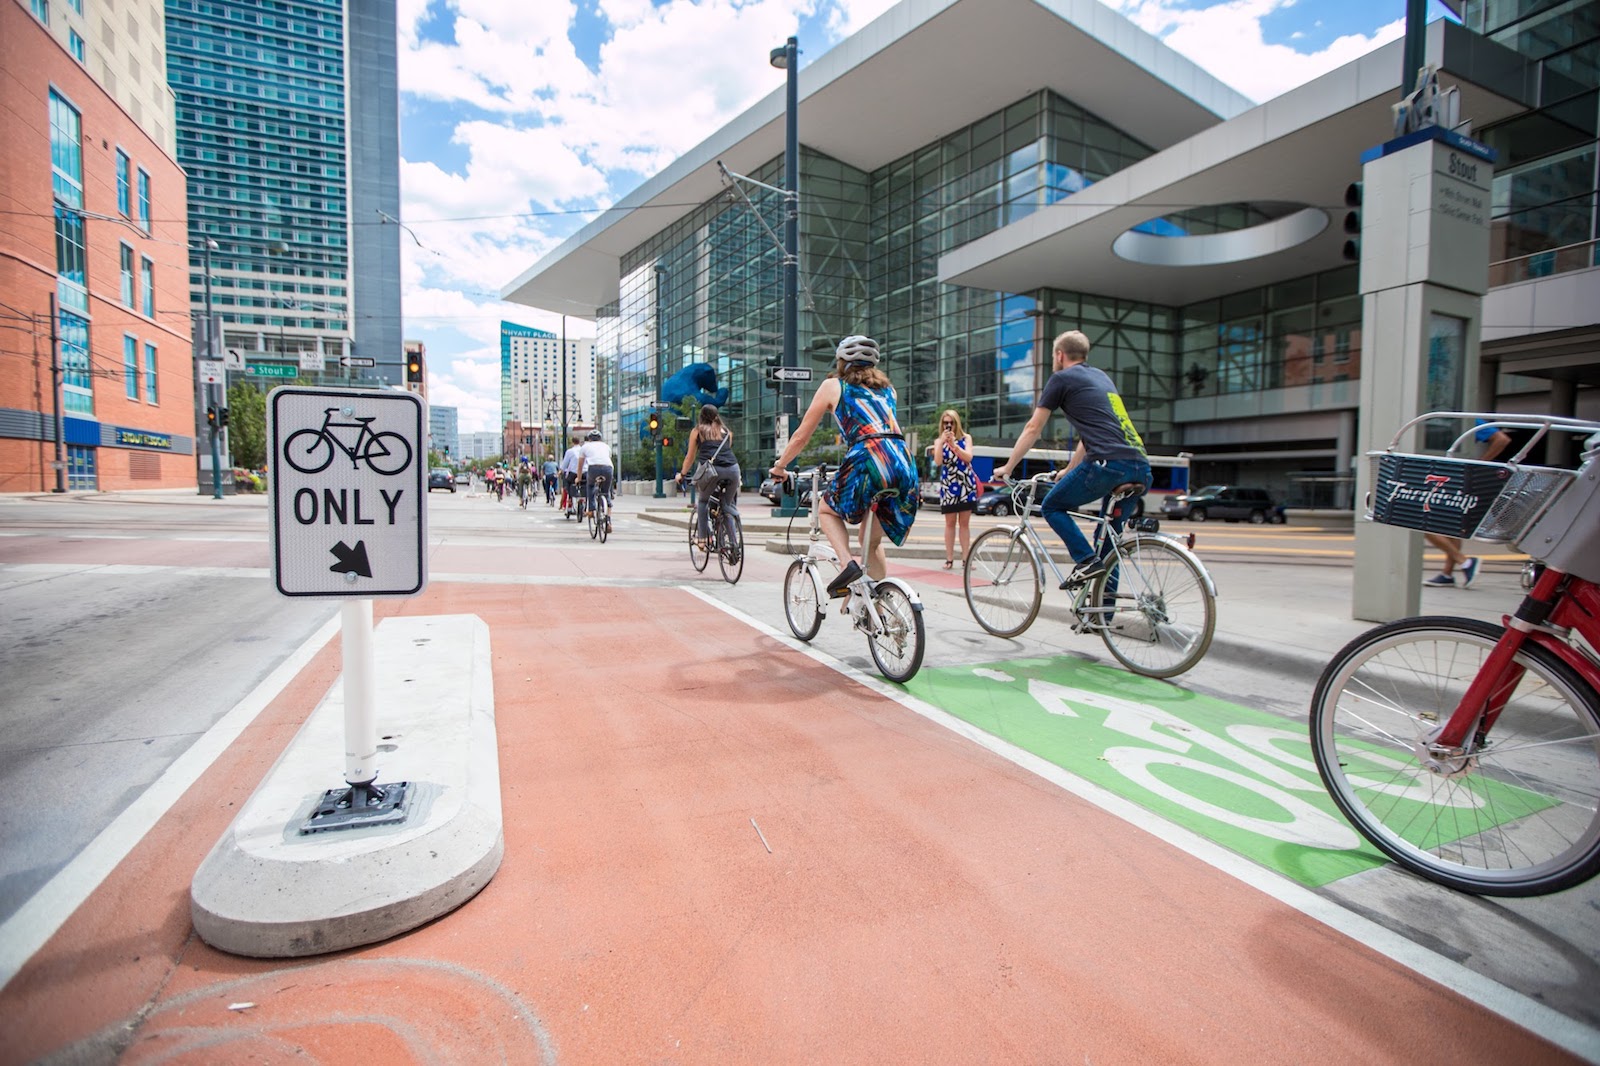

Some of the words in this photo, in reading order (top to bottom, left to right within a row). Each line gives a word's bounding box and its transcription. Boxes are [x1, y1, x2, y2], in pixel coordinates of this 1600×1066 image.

[1448, 152, 1477, 182] Stout
[122, 431, 143, 444] STOUT
[294, 487, 404, 525] ONLY
[1385, 480, 1479, 514] Friendship
[1424, 474, 1451, 512] 7
